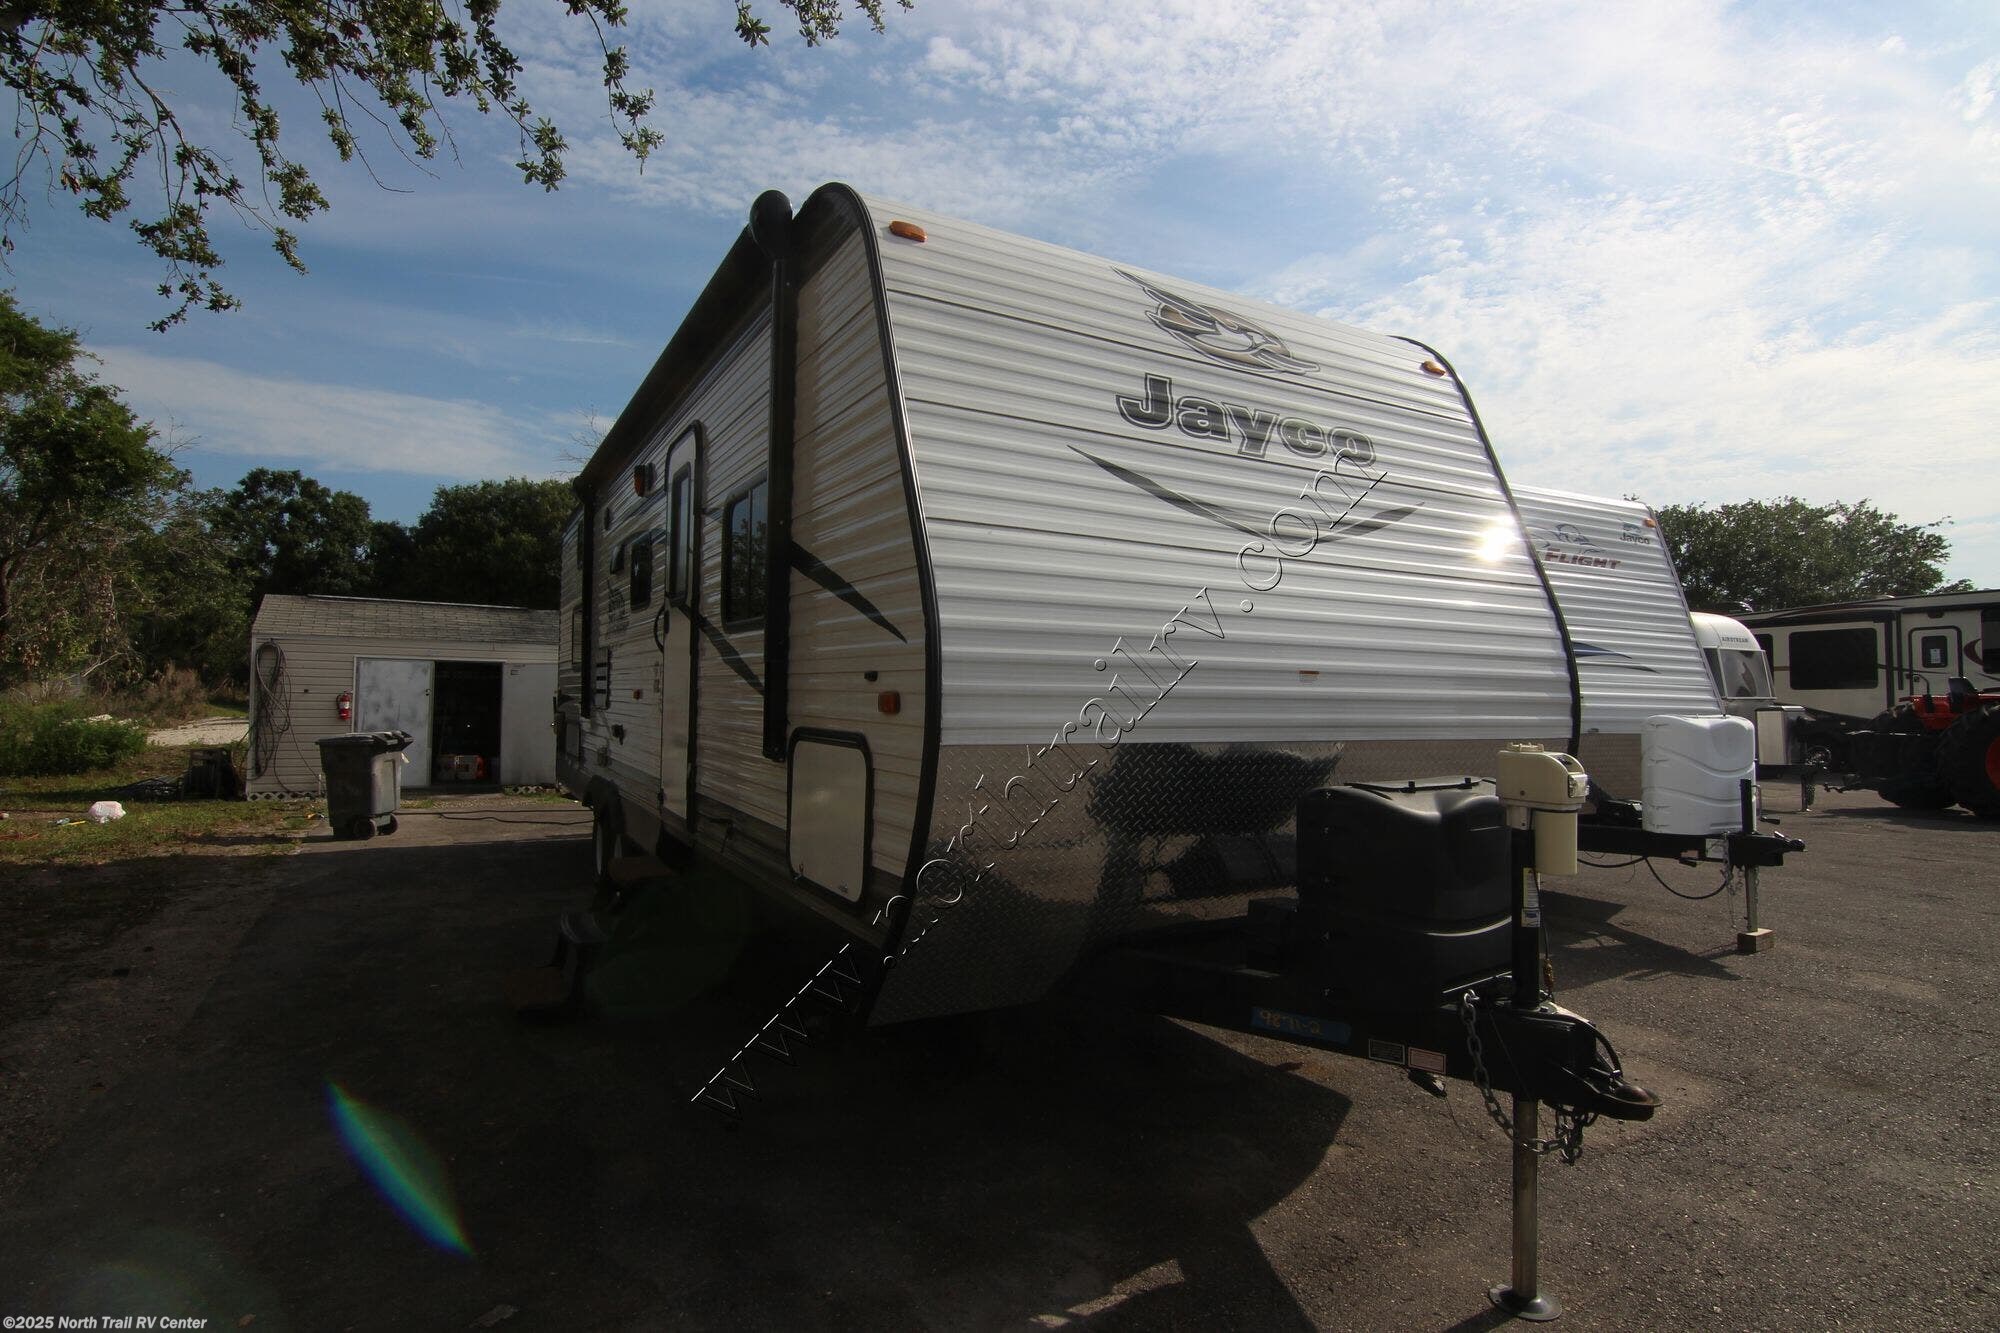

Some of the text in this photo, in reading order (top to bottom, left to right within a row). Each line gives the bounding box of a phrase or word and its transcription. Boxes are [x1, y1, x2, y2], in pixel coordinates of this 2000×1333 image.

[1115, 373, 1376, 467] Jayco
[1619, 531, 1650, 545] Jayco
[1545, 547, 1621, 569] FLIGHT
